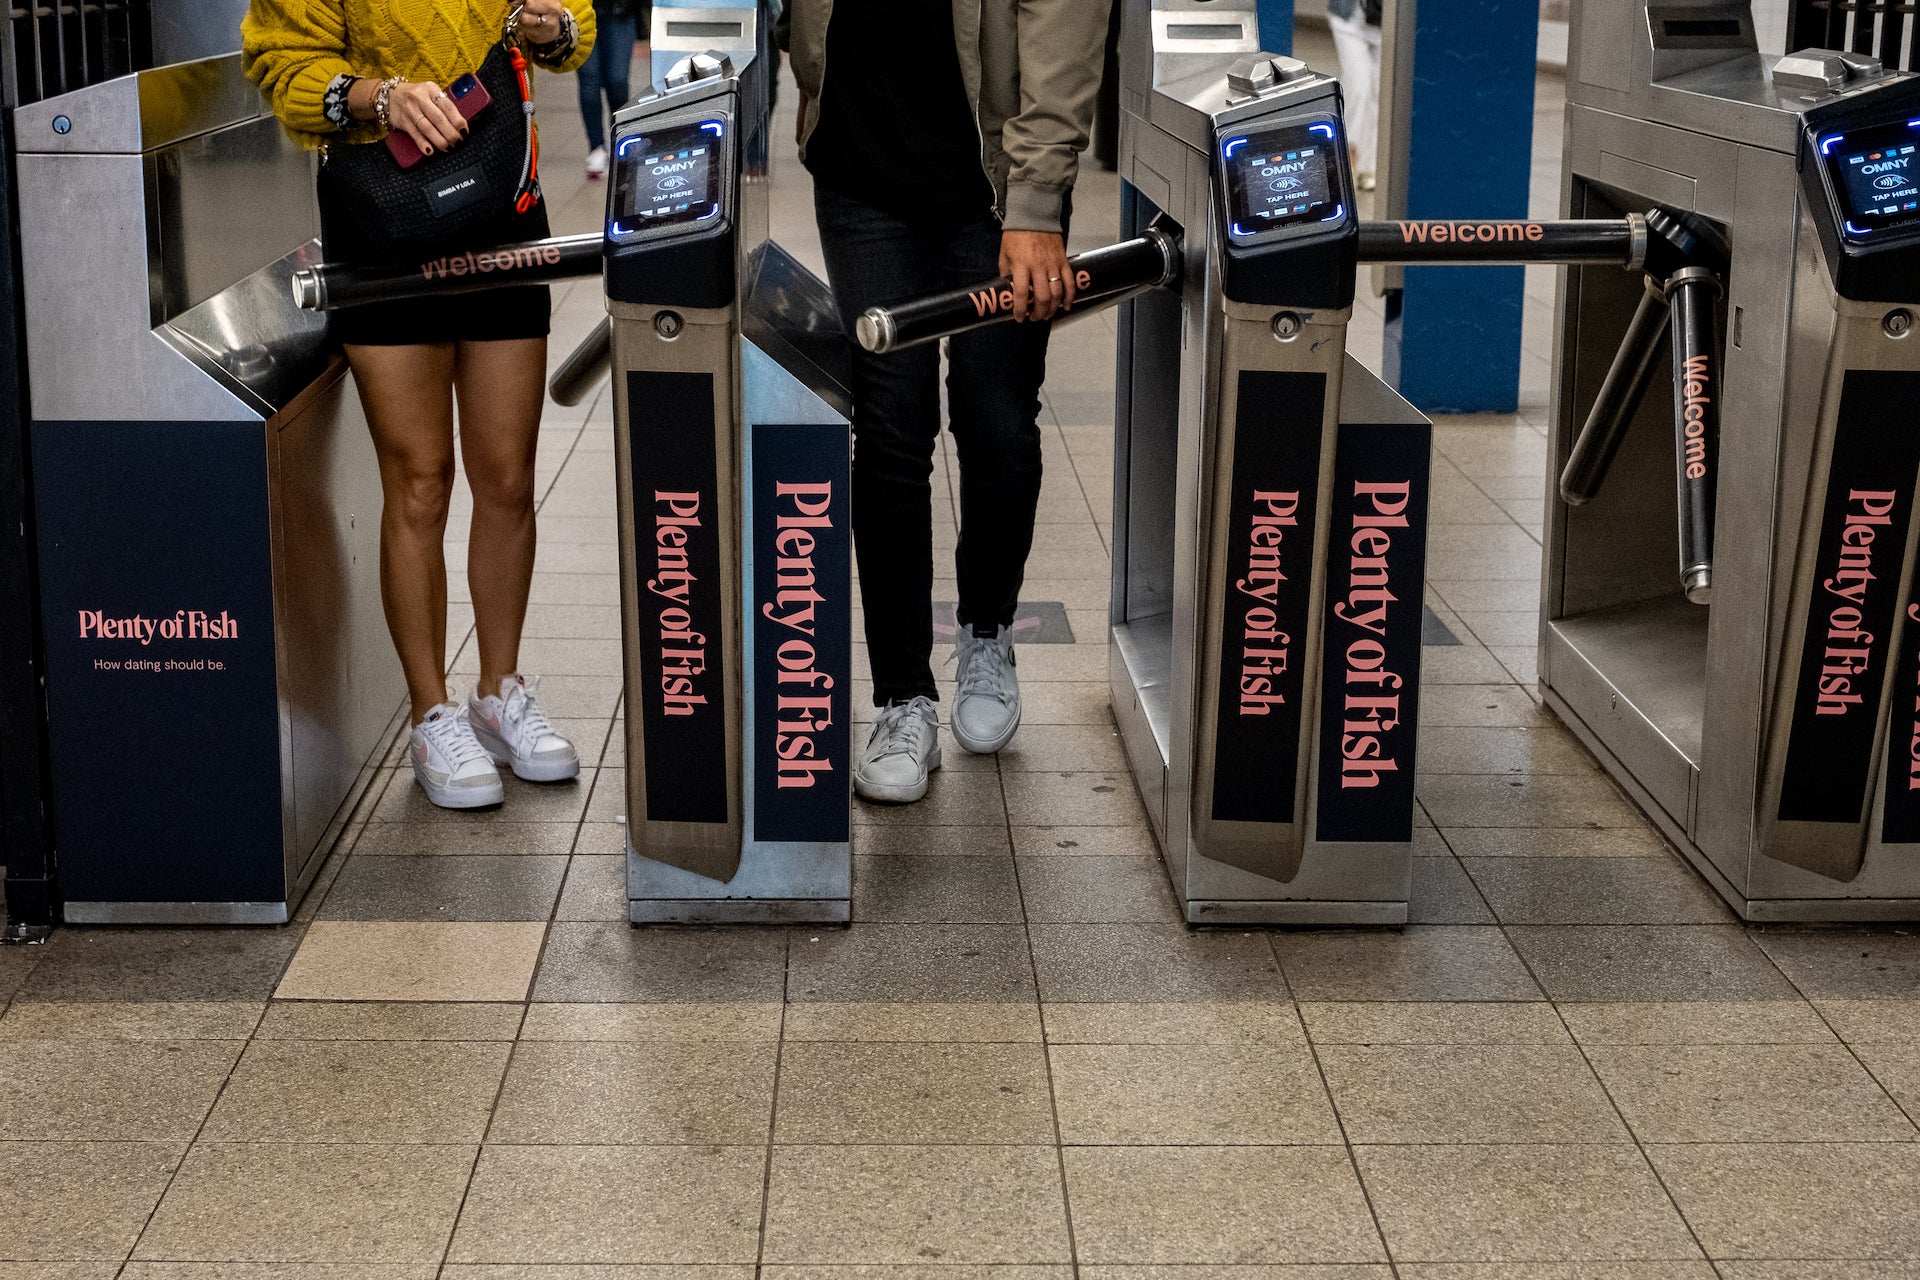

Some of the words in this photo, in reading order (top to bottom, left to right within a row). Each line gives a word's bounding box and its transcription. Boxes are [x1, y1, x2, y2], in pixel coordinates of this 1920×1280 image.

[460, 178, 476, 189] LOLA
[652, 160, 697, 175] OMNY
[1261, 161, 1307, 177] OMNY
[1861, 158, 1909, 175] OMNY
[652, 194, 668, 202] TAP
[670, 190, 693, 199] HERE
[1266, 196, 1283, 204] TAP
[1285, 191, 1309, 200] HERE
[1872, 193, 1891, 201] TAP
[1892, 188, 1918, 197] HERE
[1400, 221, 1543, 243] Welcome
[421, 246, 561, 280] Welcome
[1682, 355, 1710, 480] Welcome
[647, 489, 702, 606] Plenty
[762, 480, 833, 637] Plenty
[1236, 489, 1299, 606] Plenty
[1333, 480, 1410, 637] Plenty
[1823, 488, 1896, 605] Plenty
[78, 610, 158, 646] Plenty
[159, 610, 185, 639] of
[187, 610, 239, 640] Fish
[659, 607, 707, 645] of
[1244, 606, 1291, 645] of
[1828, 606, 1875, 644] of
[94, 659, 121, 670] How
[124, 659, 161, 672] dating
[164, 659, 204, 670] should
[207, 659, 227, 670] be.
[661, 648, 708, 717] Fish
[776, 640, 835, 690] of
[1239, 647, 1288, 717] Fish
[1346, 639, 1403, 689] of
[1815, 647, 1870, 716] Fish
[775, 694, 834, 789] Fish
[1341, 694, 1400, 789] Fish
